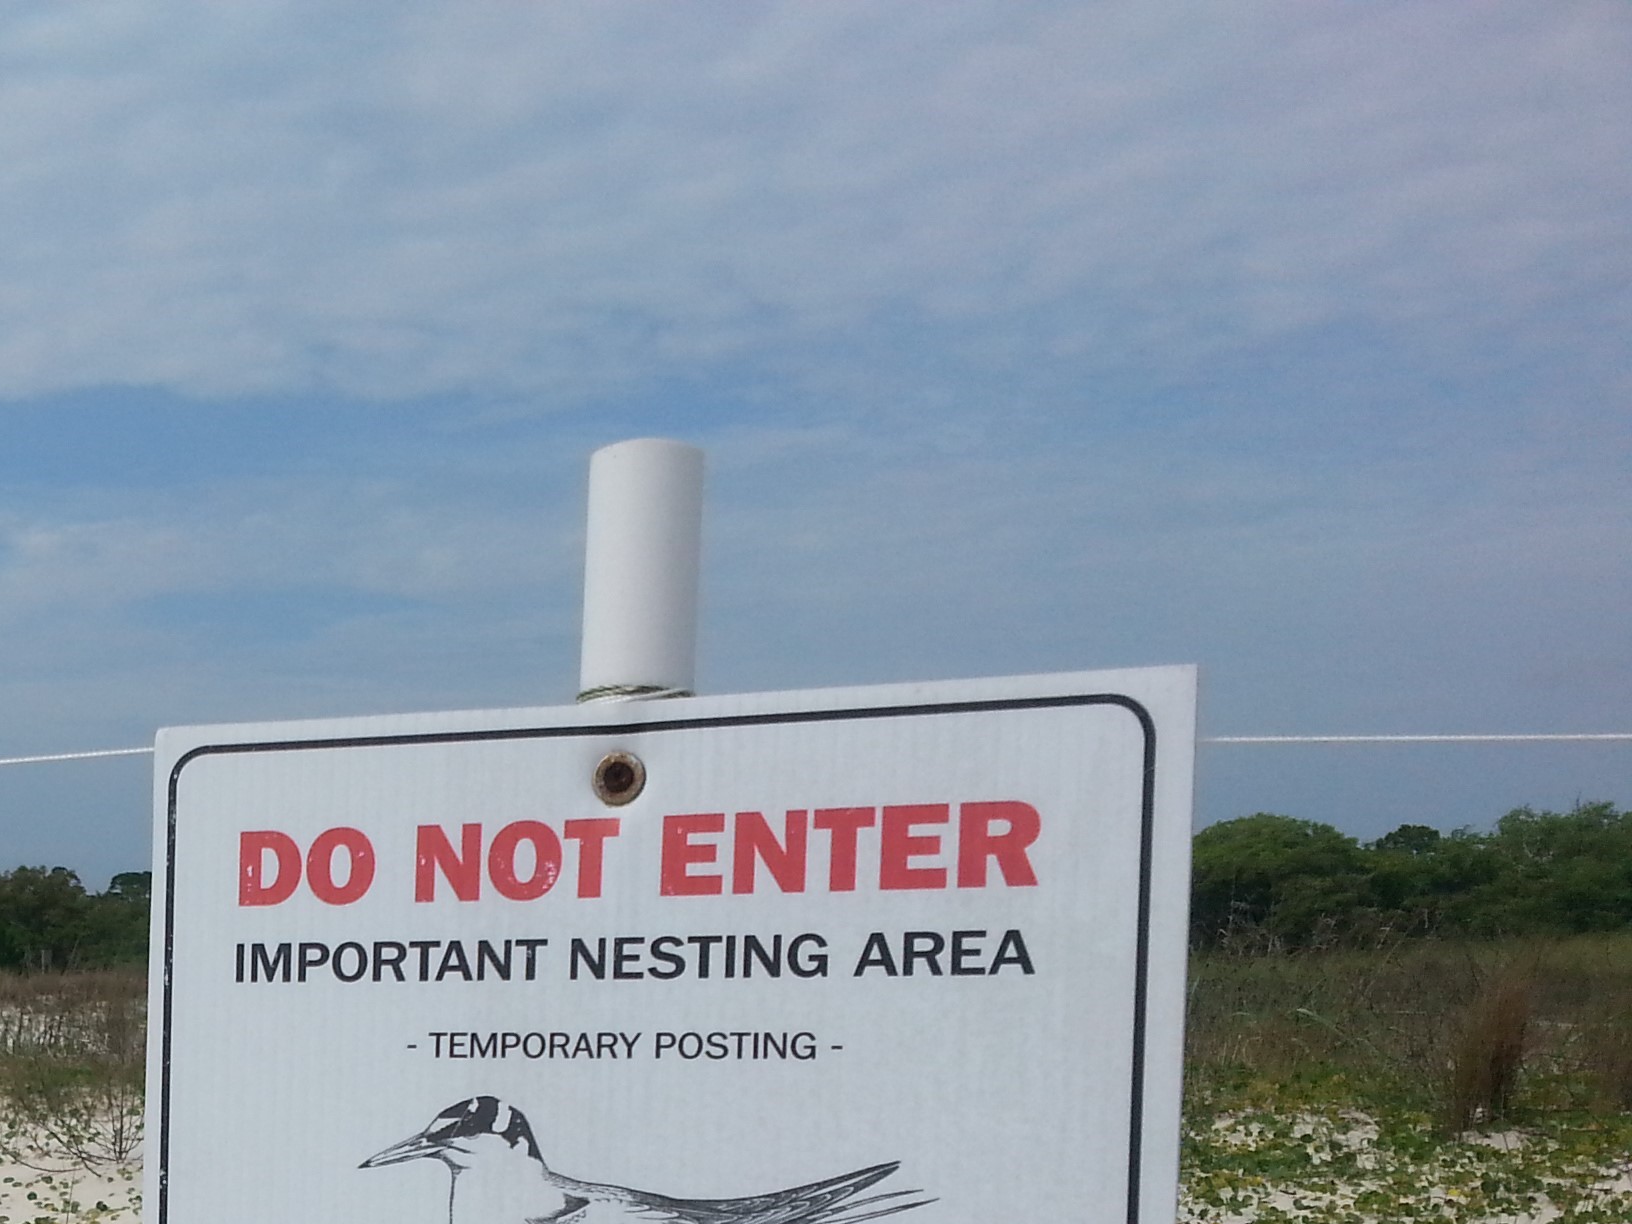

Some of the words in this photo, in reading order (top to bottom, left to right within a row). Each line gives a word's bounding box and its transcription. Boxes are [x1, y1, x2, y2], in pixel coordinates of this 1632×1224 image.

[238, 827, 376, 907] DO
[415, 817, 620, 903] NOT
[660, 800, 1041, 896] ENTER
[235, 938, 548, 983] IMPORTANT
[570, 933, 829, 980] NESTING
[853, 929, 1035, 977] AREA
[428, 1032, 642, 1059] TEMPORARY
[655, 1032, 817, 1060] POSTING
